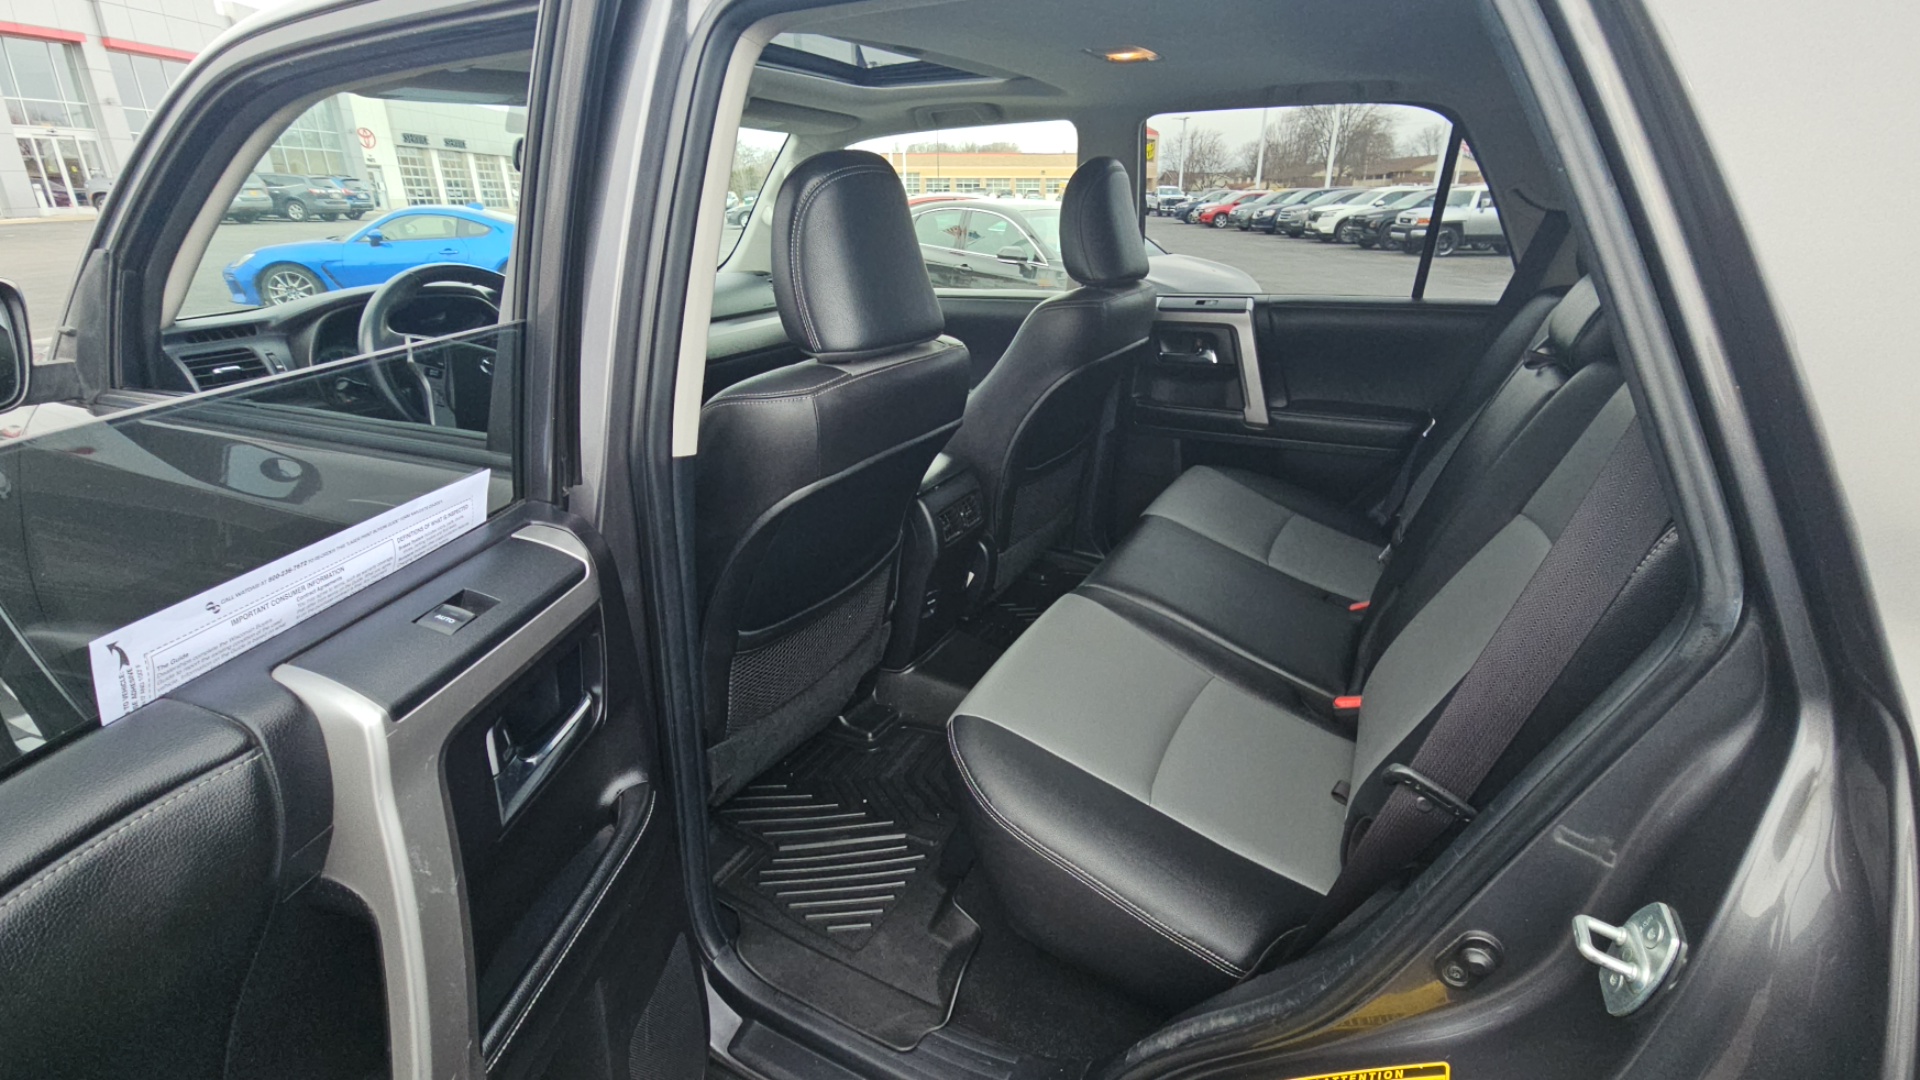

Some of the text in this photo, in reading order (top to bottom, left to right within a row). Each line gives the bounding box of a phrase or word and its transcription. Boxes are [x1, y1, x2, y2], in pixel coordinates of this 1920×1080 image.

[230, 602, 269, 627] IMPORTANT
[270, 584, 306, 608] CONSUMER
[306, 565, 344, 590] INFORMATION
[434, 614, 456, 624] AUTO
[157, 651, 189, 672] The Guide
[122, 700, 130, 711] TO
[1323, 1069, 1404, 1080] TENTION
